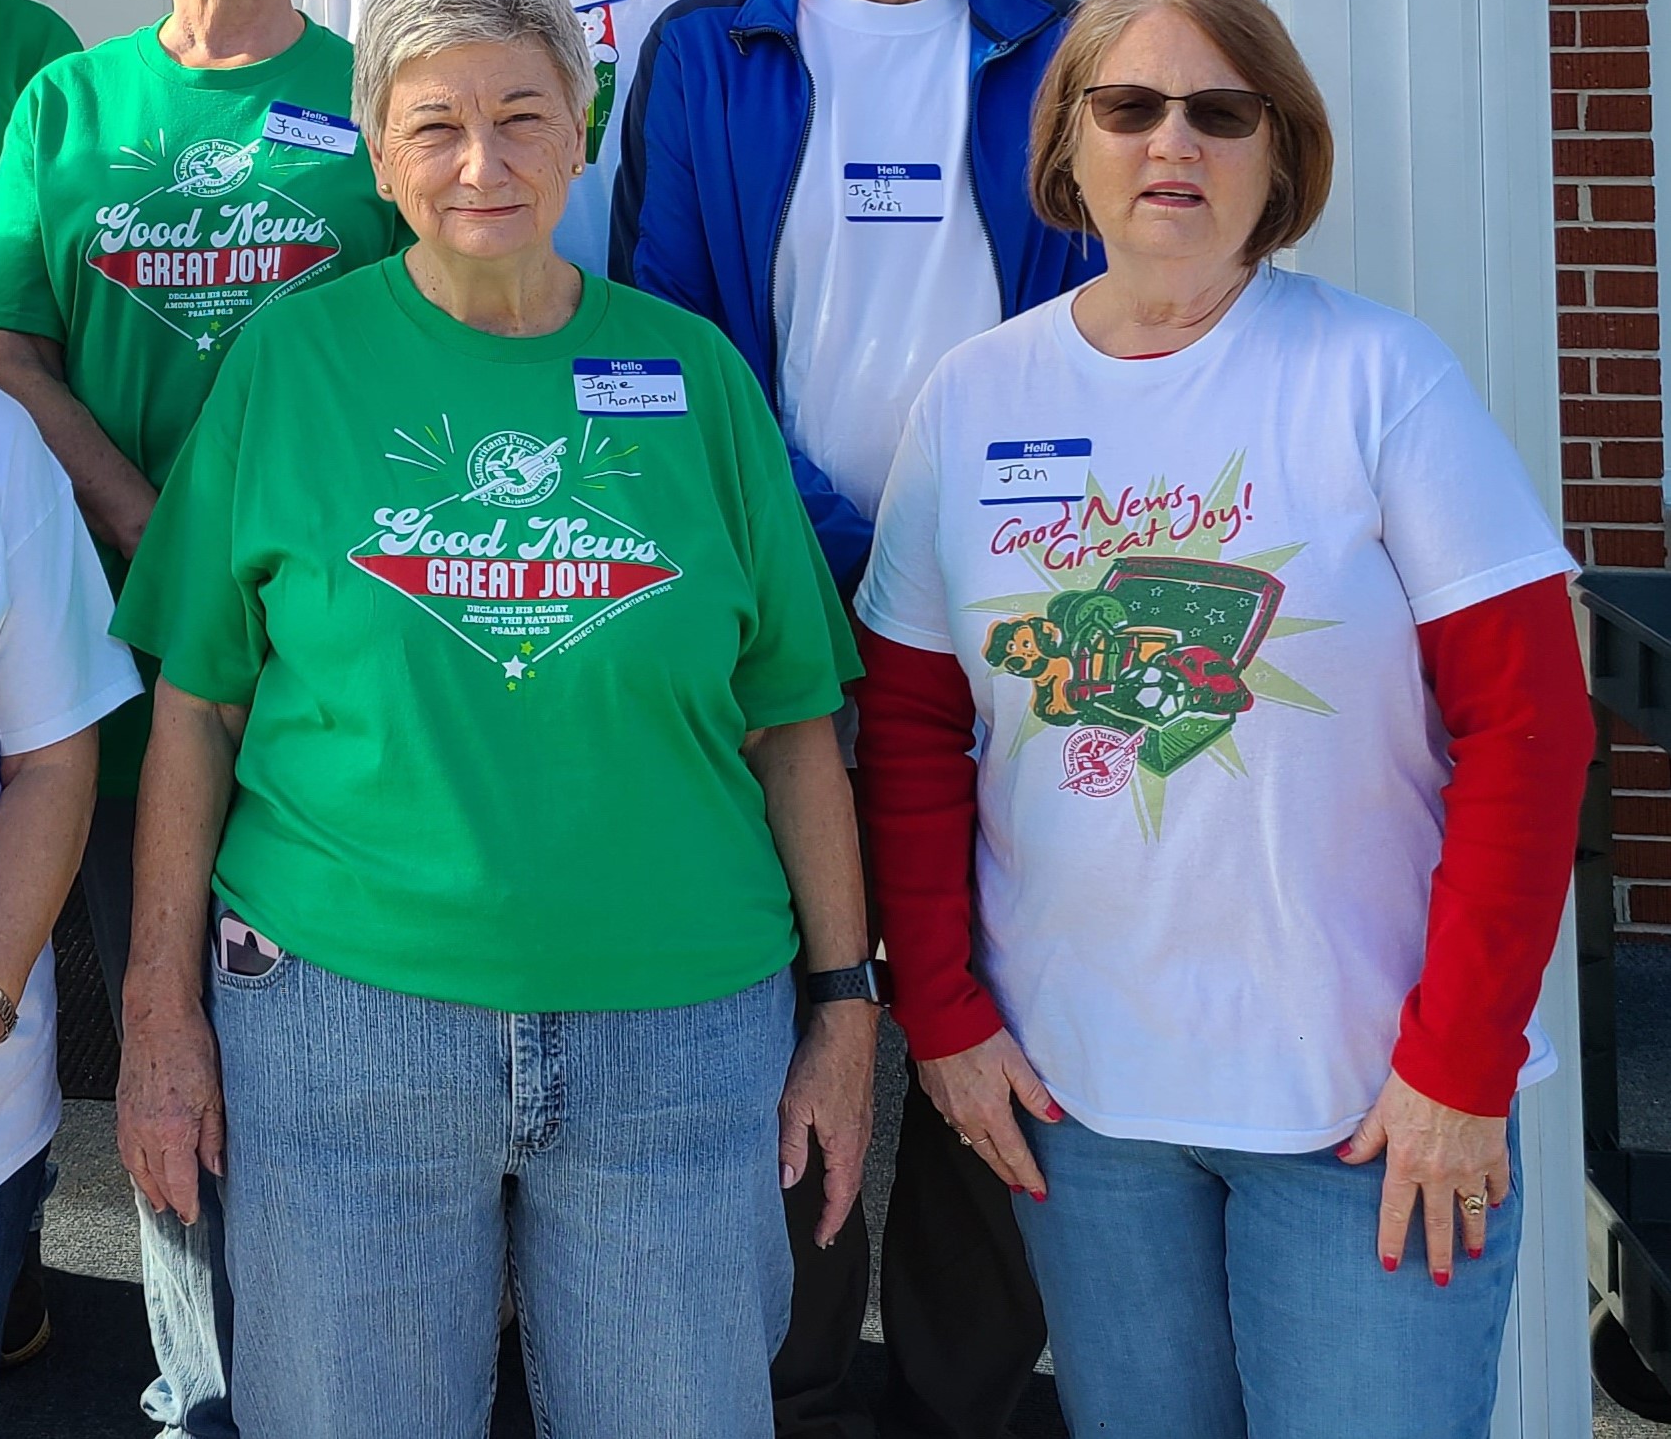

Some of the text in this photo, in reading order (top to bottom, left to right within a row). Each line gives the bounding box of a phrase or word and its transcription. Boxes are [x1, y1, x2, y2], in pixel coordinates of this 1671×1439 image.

[301, 109, 328, 122] Hello
[877, 165, 907, 175] Hello
[96, 200, 326, 253] Good News
[136, 246, 282, 286] GREAT JOY!
[168, 292, 206, 300] DECLARE
[221, 289, 249, 297] GLORY
[164, 301, 195, 309] AMONG
[196, 300, 212, 308] THE
[610, 361, 643, 371] Hello
[582, 375, 634, 390] Janie
[1023, 442, 1055, 453] Hello
[474, 434, 540, 486] Samaritan's Purse
[509, 466, 553, 493] OPERATION
[998, 464, 1048, 483] Jan
[498, 493, 541, 505] Christmas
[990, 483, 1185, 555] Good News
[1043, 482, 1253, 570] Great Joy!
[373, 507, 659, 562] Good News
[427, 558, 610, 598] GREAT JOY!
[466, 604, 569, 614] DECLARE HIS GLORY
[461, 614, 574, 625] AMONG THE NATIONS!
[491, 626, 527, 635] PSALM
[563, 624, 595, 650] PROJECT
[595, 616, 607, 627] OF
[1094, 729, 1122, 744] Purse
